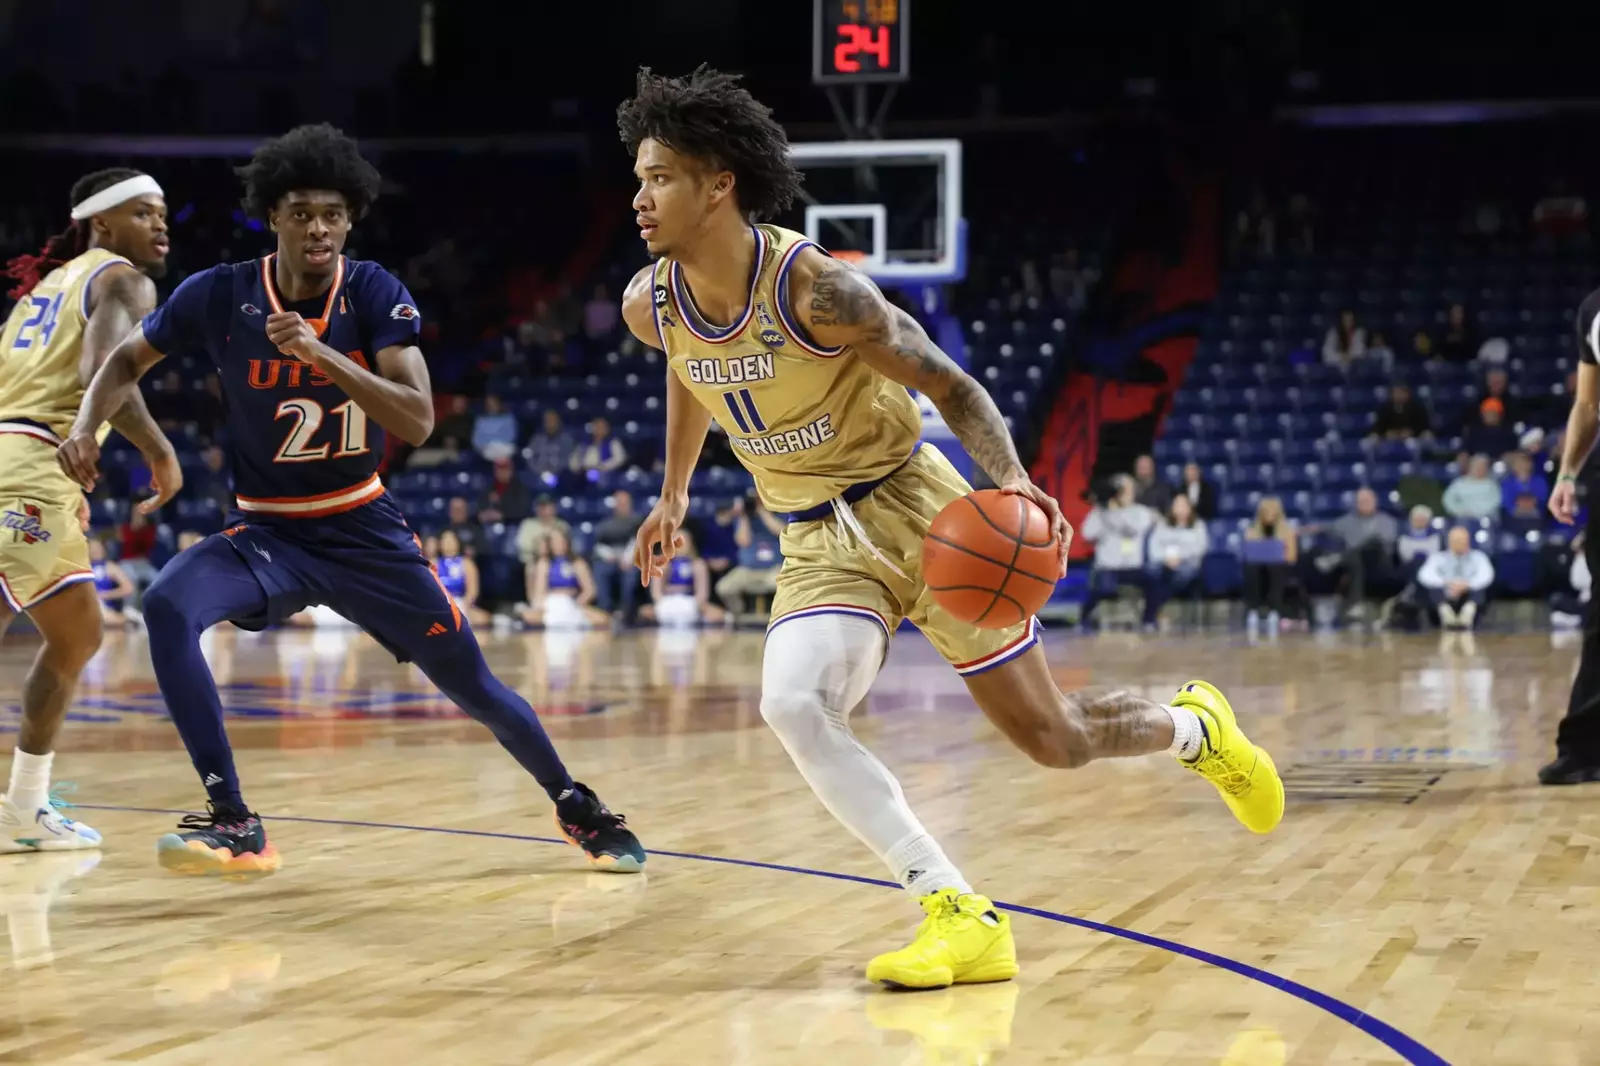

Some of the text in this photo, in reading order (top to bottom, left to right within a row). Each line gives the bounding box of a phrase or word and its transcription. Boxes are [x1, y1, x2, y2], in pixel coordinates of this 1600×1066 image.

[834, 23, 889, 72] 24
[12, 291, 64, 350] 24
[763, 334, 784, 343] DOC
[247, 350, 372, 390] UTS
[686, 353, 775, 384] GOLDEN
[273, 398, 370, 463] 21
[722, 388, 768, 434] 11
